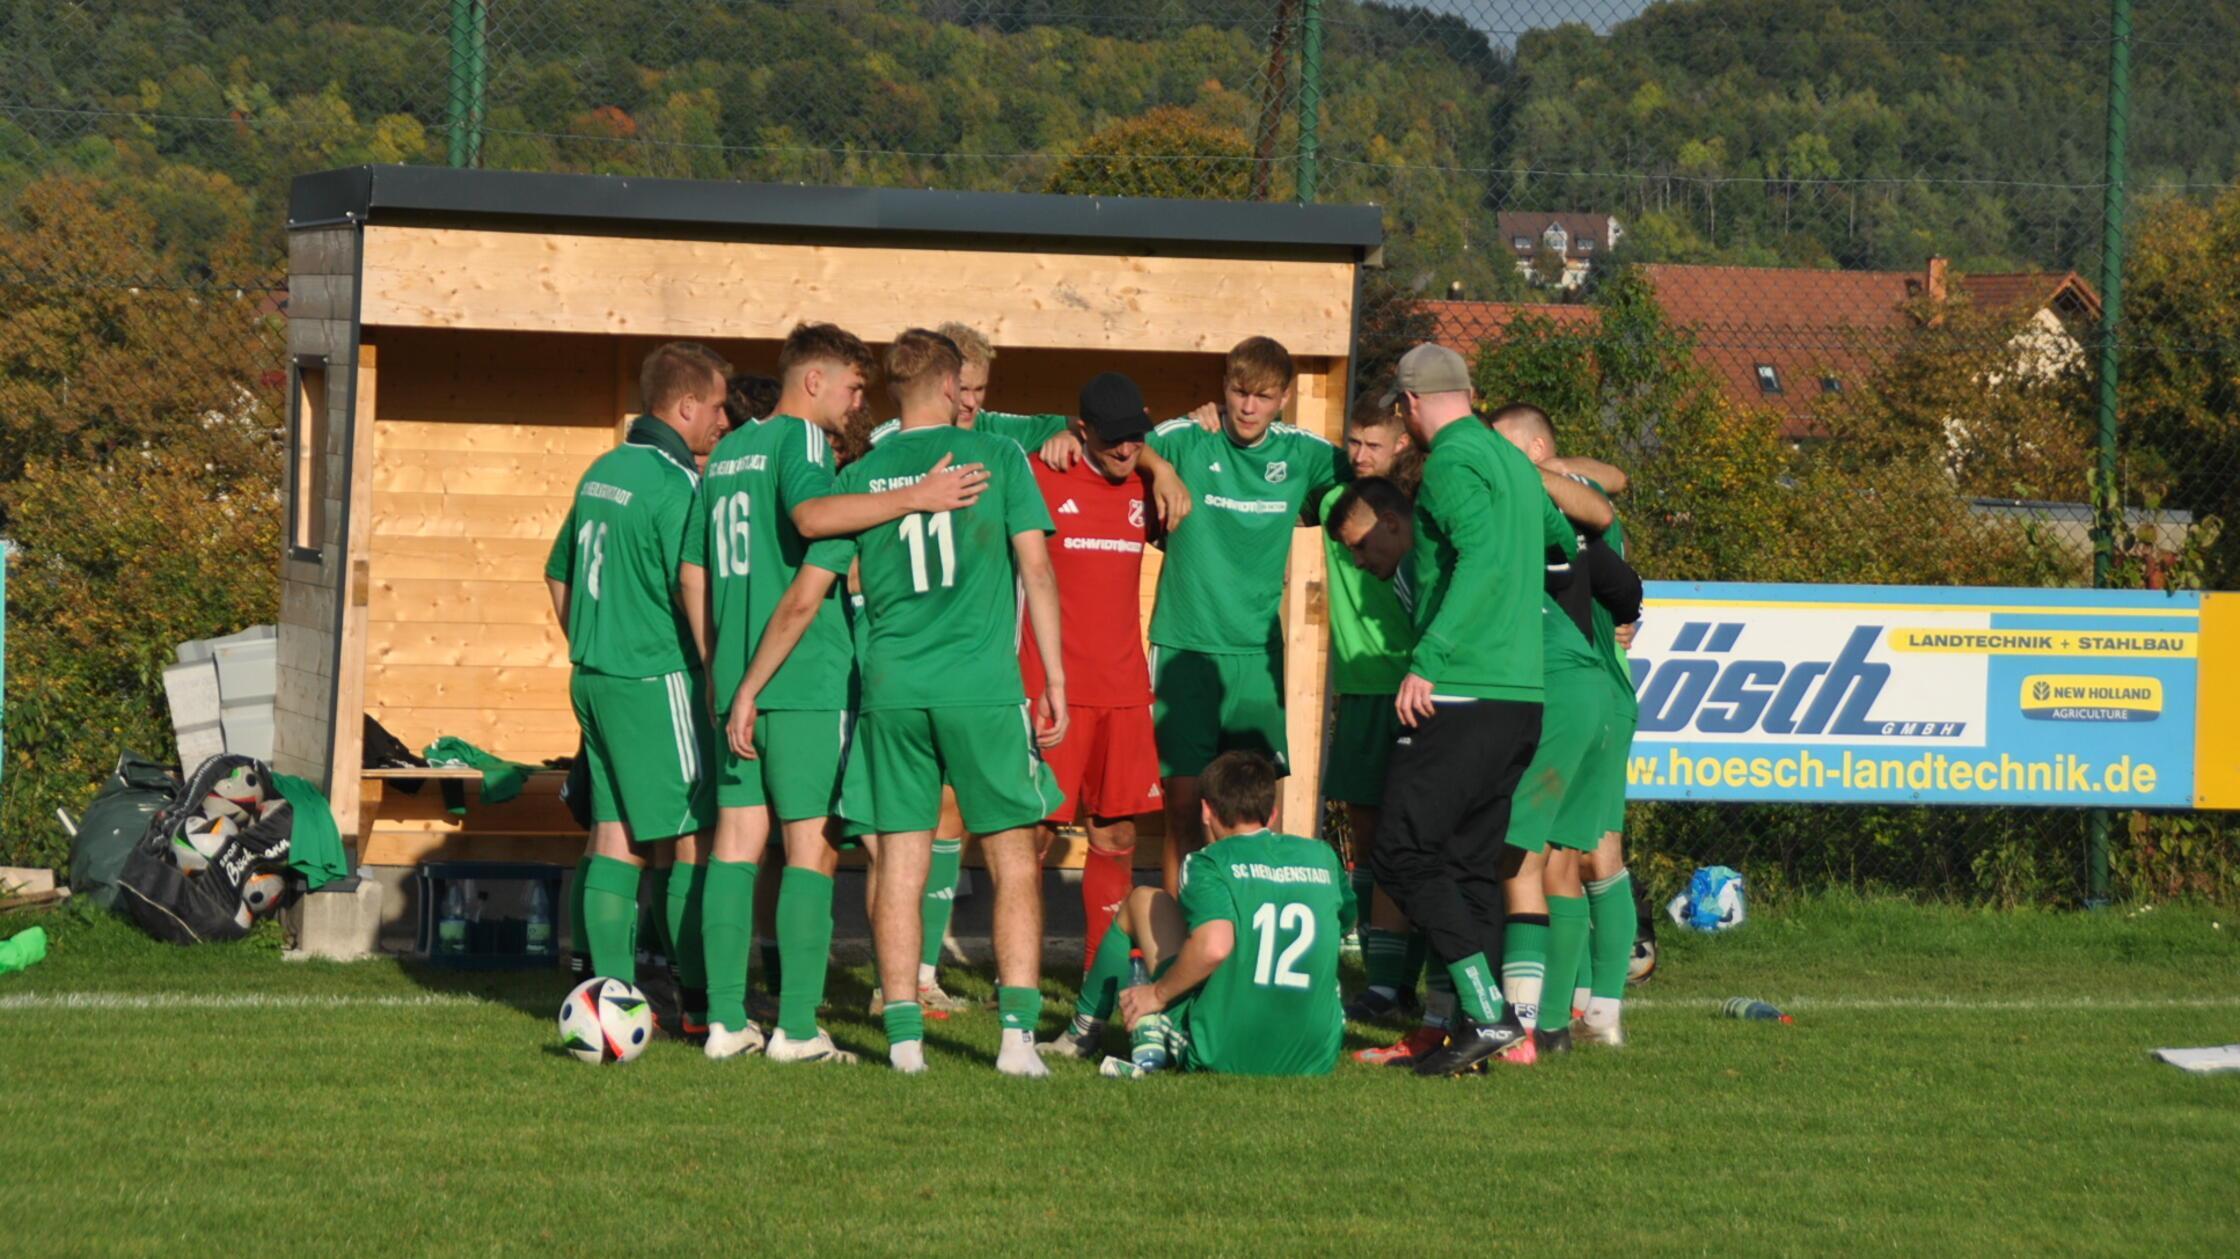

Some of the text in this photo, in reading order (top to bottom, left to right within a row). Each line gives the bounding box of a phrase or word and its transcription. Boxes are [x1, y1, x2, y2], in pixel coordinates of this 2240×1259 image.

[712, 491, 750, 579] 16
[899, 511, 956, 593] 11
[1908, 634, 2053, 650] LANDTECHNIK
[2078, 637, 2185, 652] STAHLBAU
[2054, 686, 2151, 700] NEW HOLLAND
[2052, 708, 2128, 720] AGRICULTURE
[1231, 863, 1249, 879] SC
[1252, 902, 1316, 988] 12
